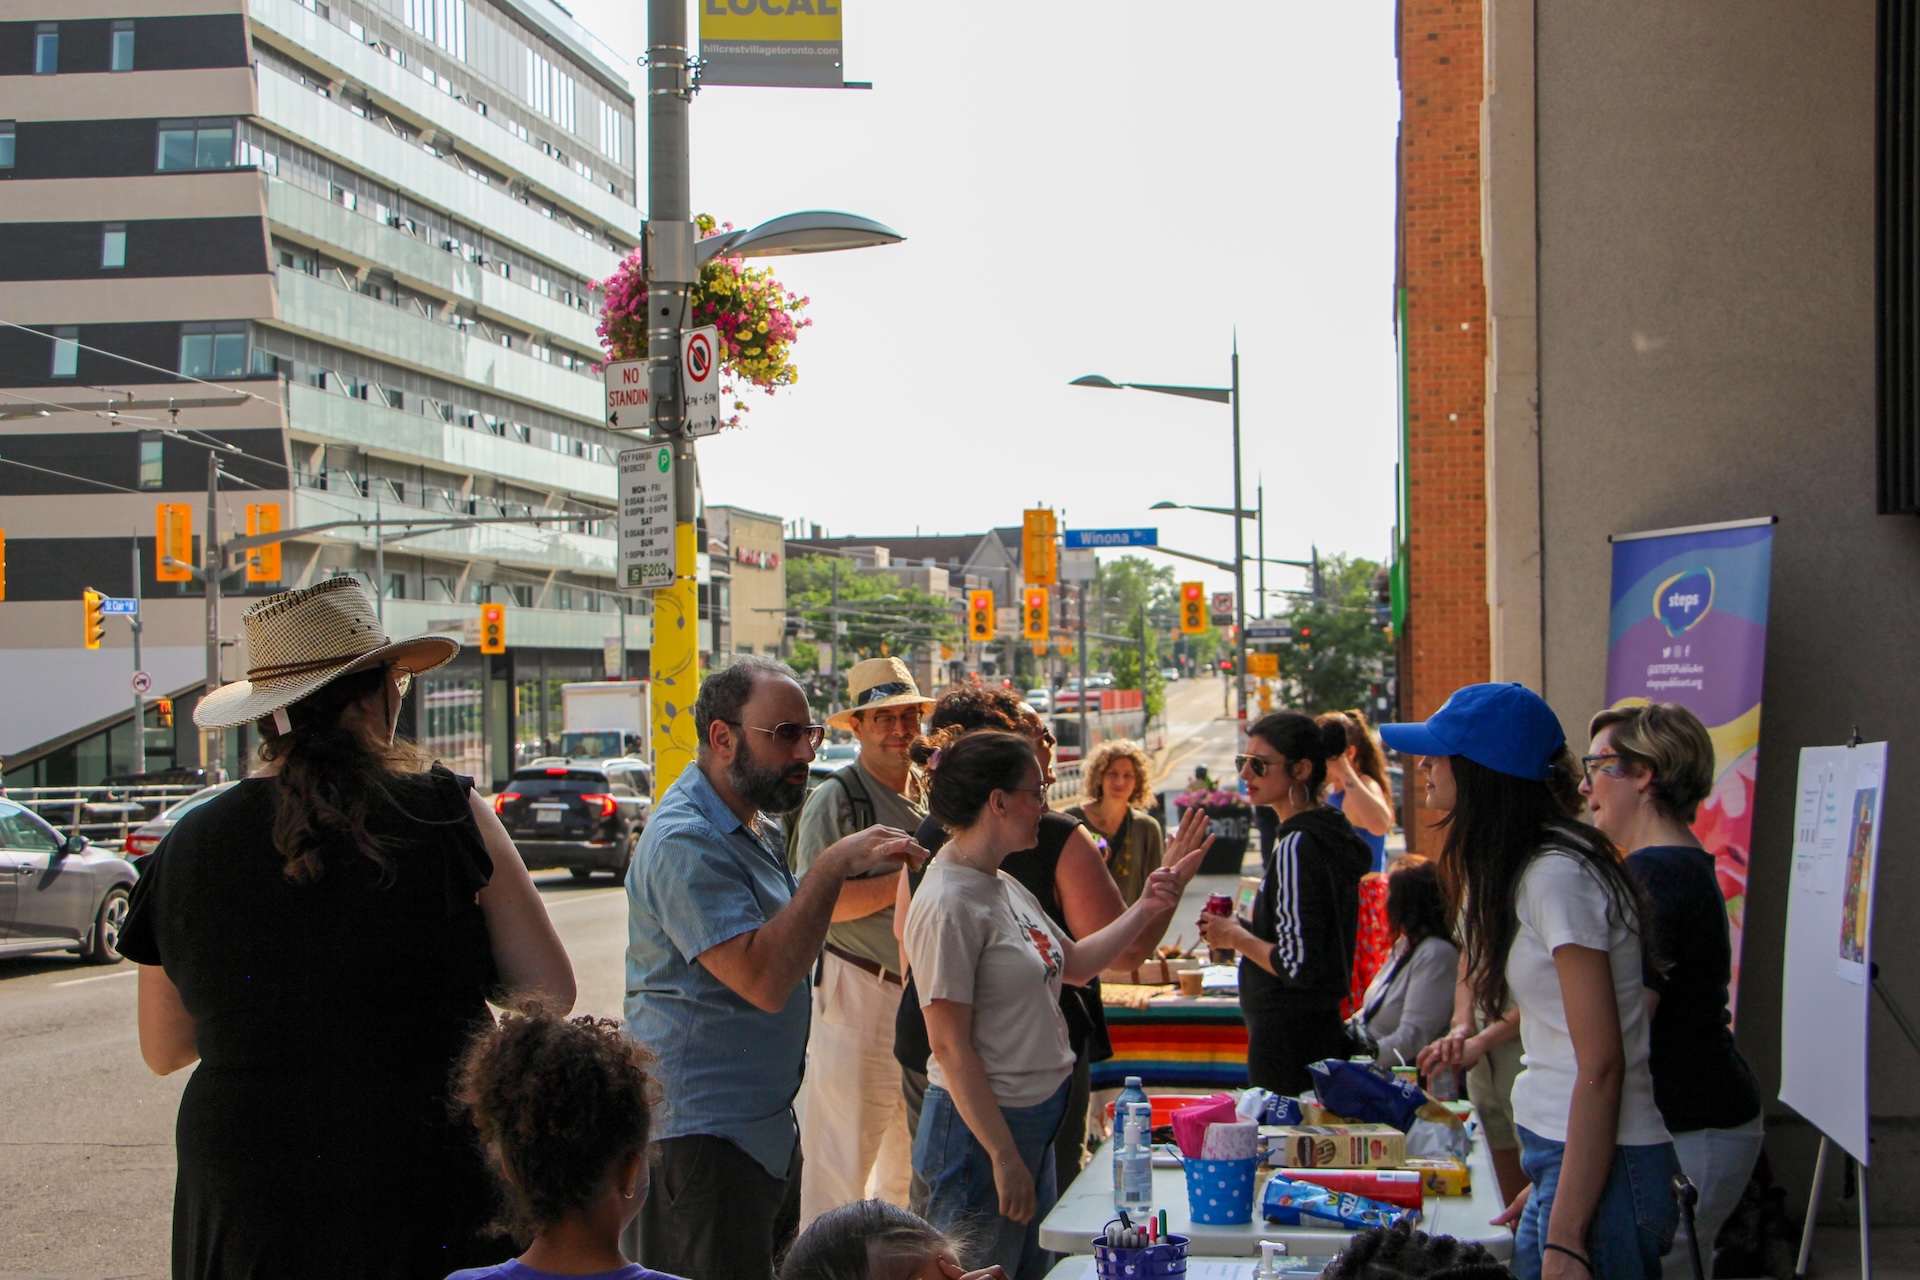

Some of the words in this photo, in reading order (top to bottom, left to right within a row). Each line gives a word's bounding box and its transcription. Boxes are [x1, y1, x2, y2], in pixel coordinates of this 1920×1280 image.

[703, 44, 839, 57] hillcrestvillagetoronto.com
[623, 367, 639, 385] NO
[609, 388, 649, 407] STANDIN
[620, 454, 630, 463] PAY
[631, 451, 652, 462] PARKING
[620, 463, 646, 474] ENFORCED
[632, 485, 647, 494] MON
[651, 483, 661, 492] FRI
[640, 516, 653, 526] SAT
[640, 538, 654, 547] SUN
[1081, 531, 1130, 545] Winona
[642, 563, 667, 577] 5203
[1668, 592, 1699, 613] steps
